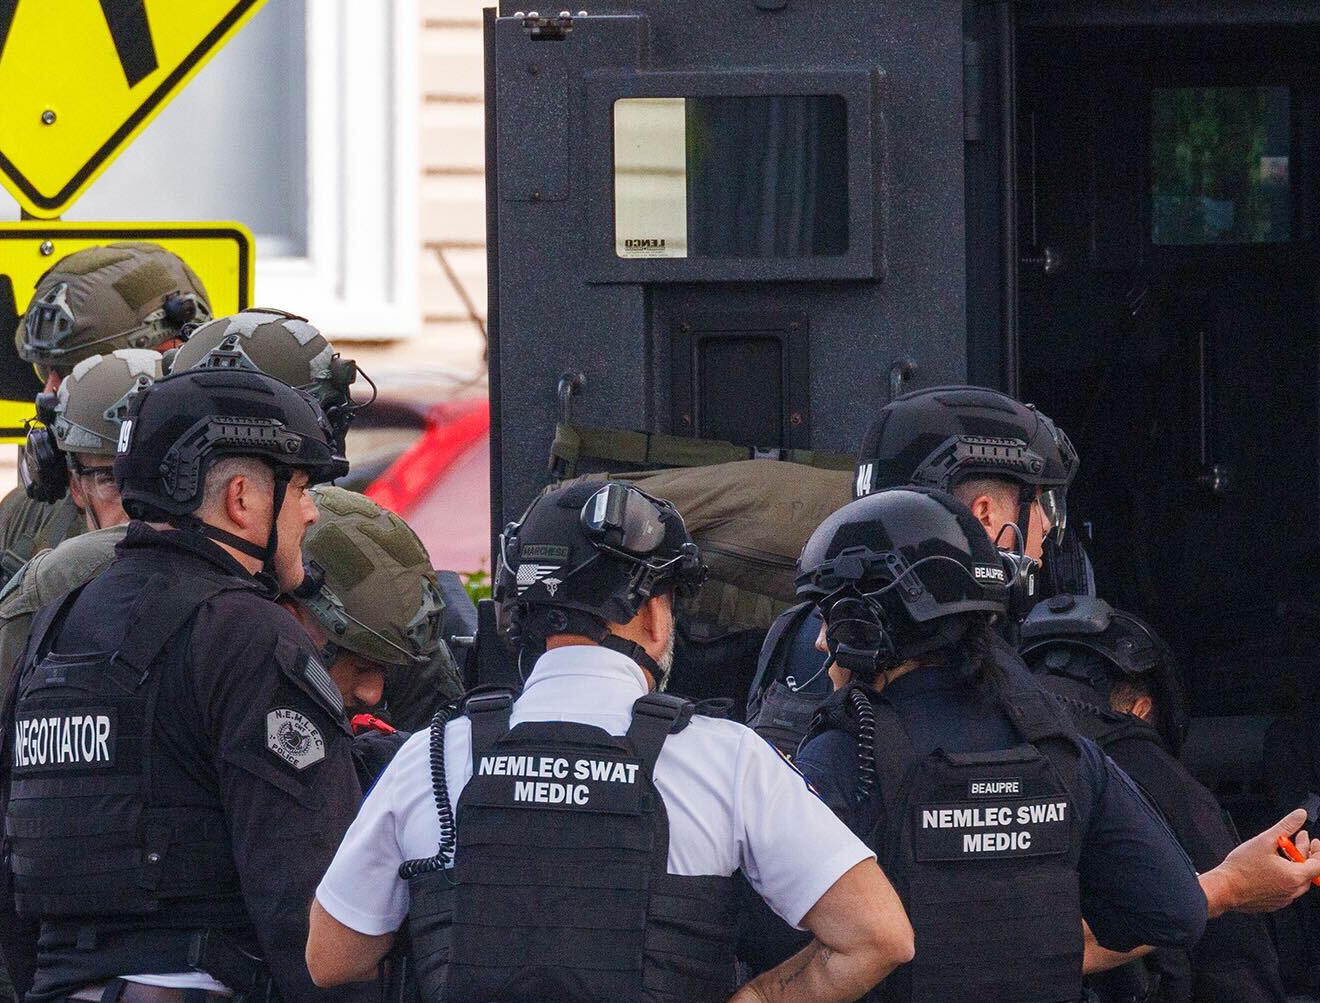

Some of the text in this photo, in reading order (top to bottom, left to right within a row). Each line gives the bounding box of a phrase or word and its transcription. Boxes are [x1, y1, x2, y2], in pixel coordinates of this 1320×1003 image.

[974, 566, 1005, 581] BEAUPRE
[15, 715, 111, 767] NEGOTIATOR
[271, 743, 300, 766] POLICE
[478, 756, 639, 784] NEMLEC SWAT
[513, 781, 590, 805] MEDIC
[971, 781, 1020, 794] BEAUPRE
[922, 802, 1067, 829] NEMLEC SWAT
[963, 831, 1032, 853] MEDIC
